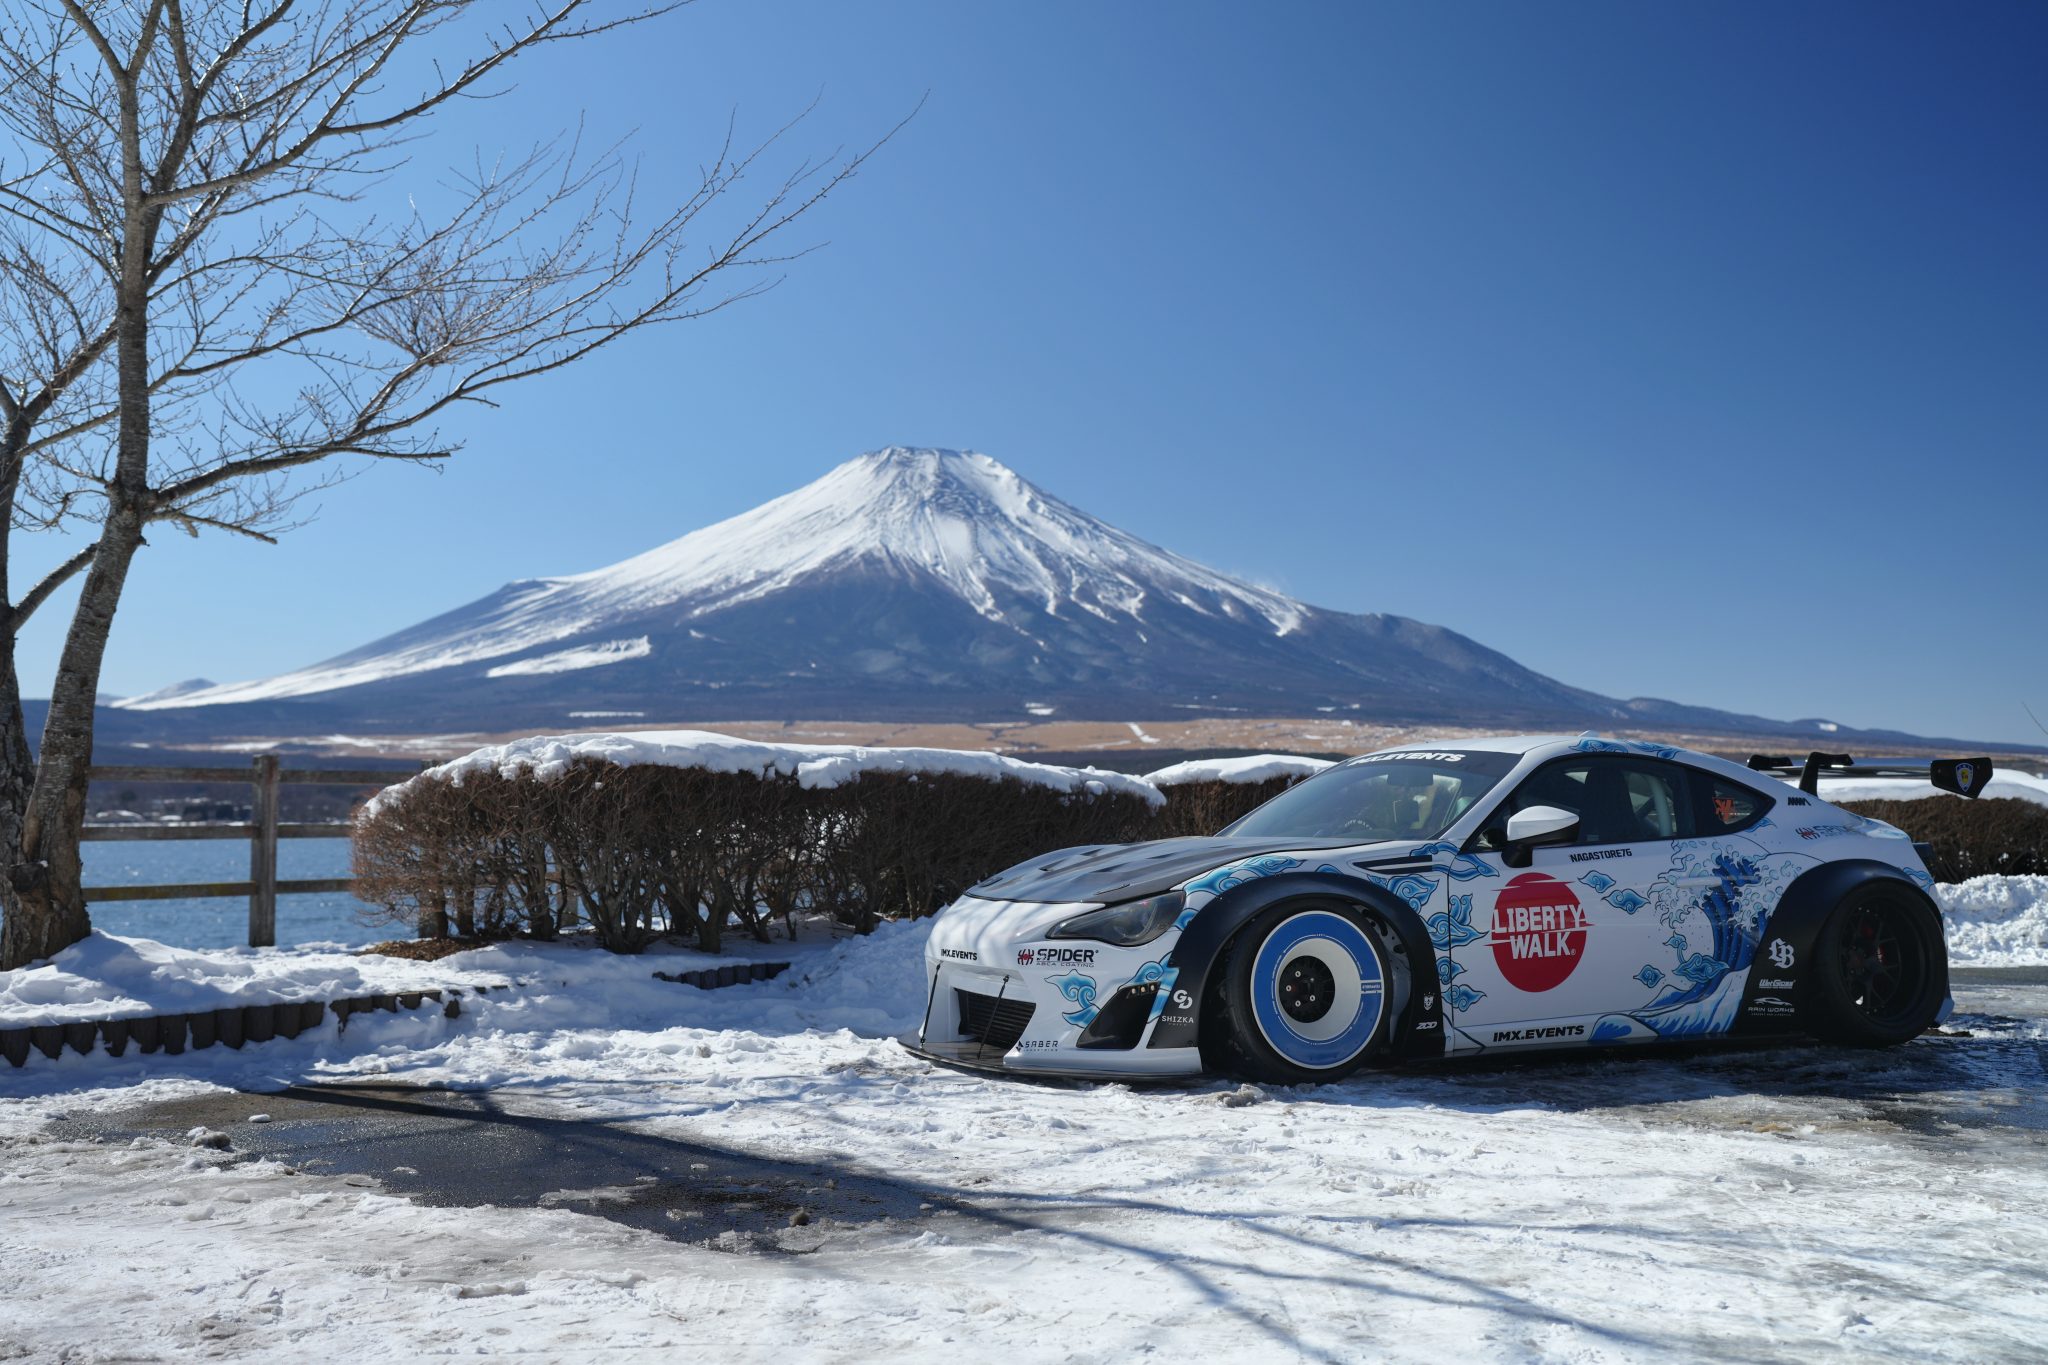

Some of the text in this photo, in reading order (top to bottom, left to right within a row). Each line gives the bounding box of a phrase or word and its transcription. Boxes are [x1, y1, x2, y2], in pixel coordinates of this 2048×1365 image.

[1570, 848, 1632, 862] NAGASTORE76
[1494, 904, 1585, 934] LIBERTY
[1510, 931, 1571, 959] WALK
[941, 949, 978, 961] IMX.EVENTS
[1037, 949, 1095, 962] SPIDER
[1161, 1015, 1194, 1024] SHIZKA
[1493, 1025, 1585, 1042] IMX.EVENTS
[1025, 1040, 1058, 1048] SABER
